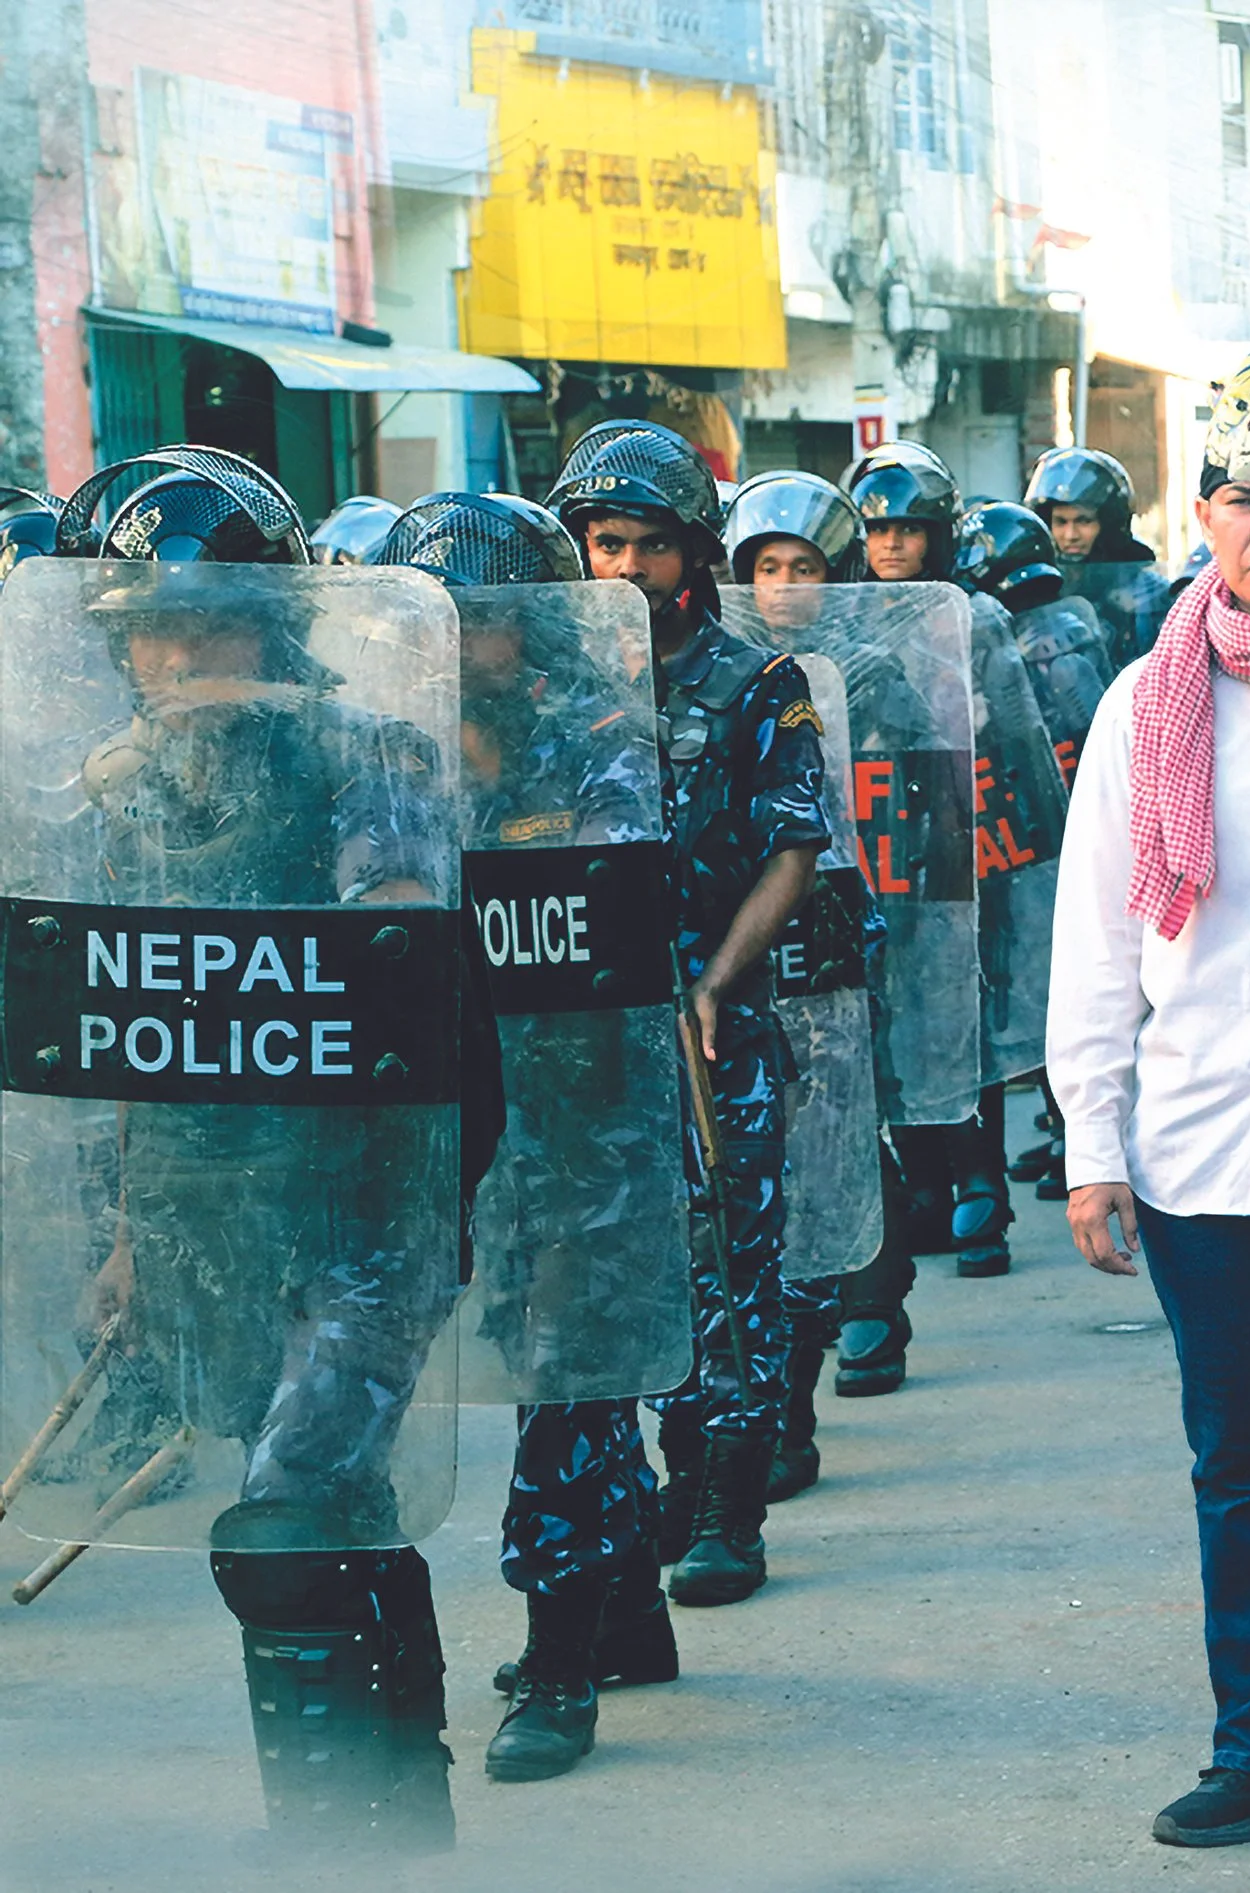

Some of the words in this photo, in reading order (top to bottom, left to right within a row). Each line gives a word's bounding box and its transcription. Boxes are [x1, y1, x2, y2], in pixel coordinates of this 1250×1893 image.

[86, 930, 346, 994] NEPAL
[474, 896, 590, 967] OLICE
[79, 1014, 354, 1077] POLICE
